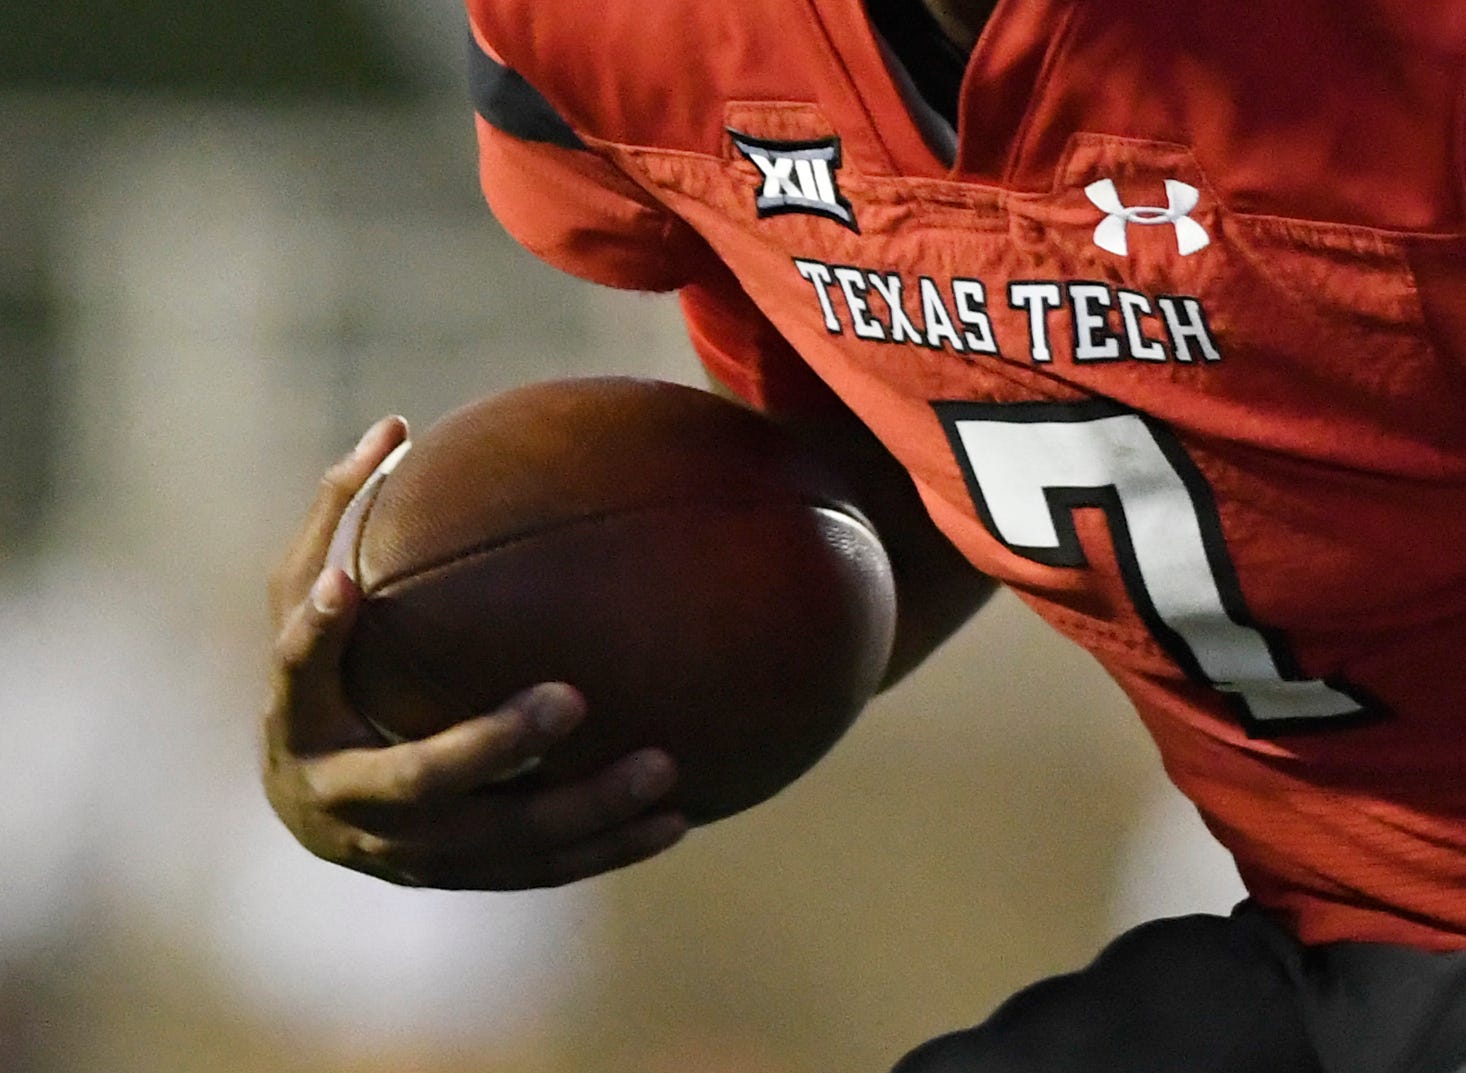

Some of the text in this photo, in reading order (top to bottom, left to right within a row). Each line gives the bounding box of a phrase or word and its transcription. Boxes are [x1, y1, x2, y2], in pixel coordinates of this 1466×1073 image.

[740, 142, 846, 215] XII
[792, 257, 1221, 364] TEXAS TECH
[936, 401, 1385, 736] 7
